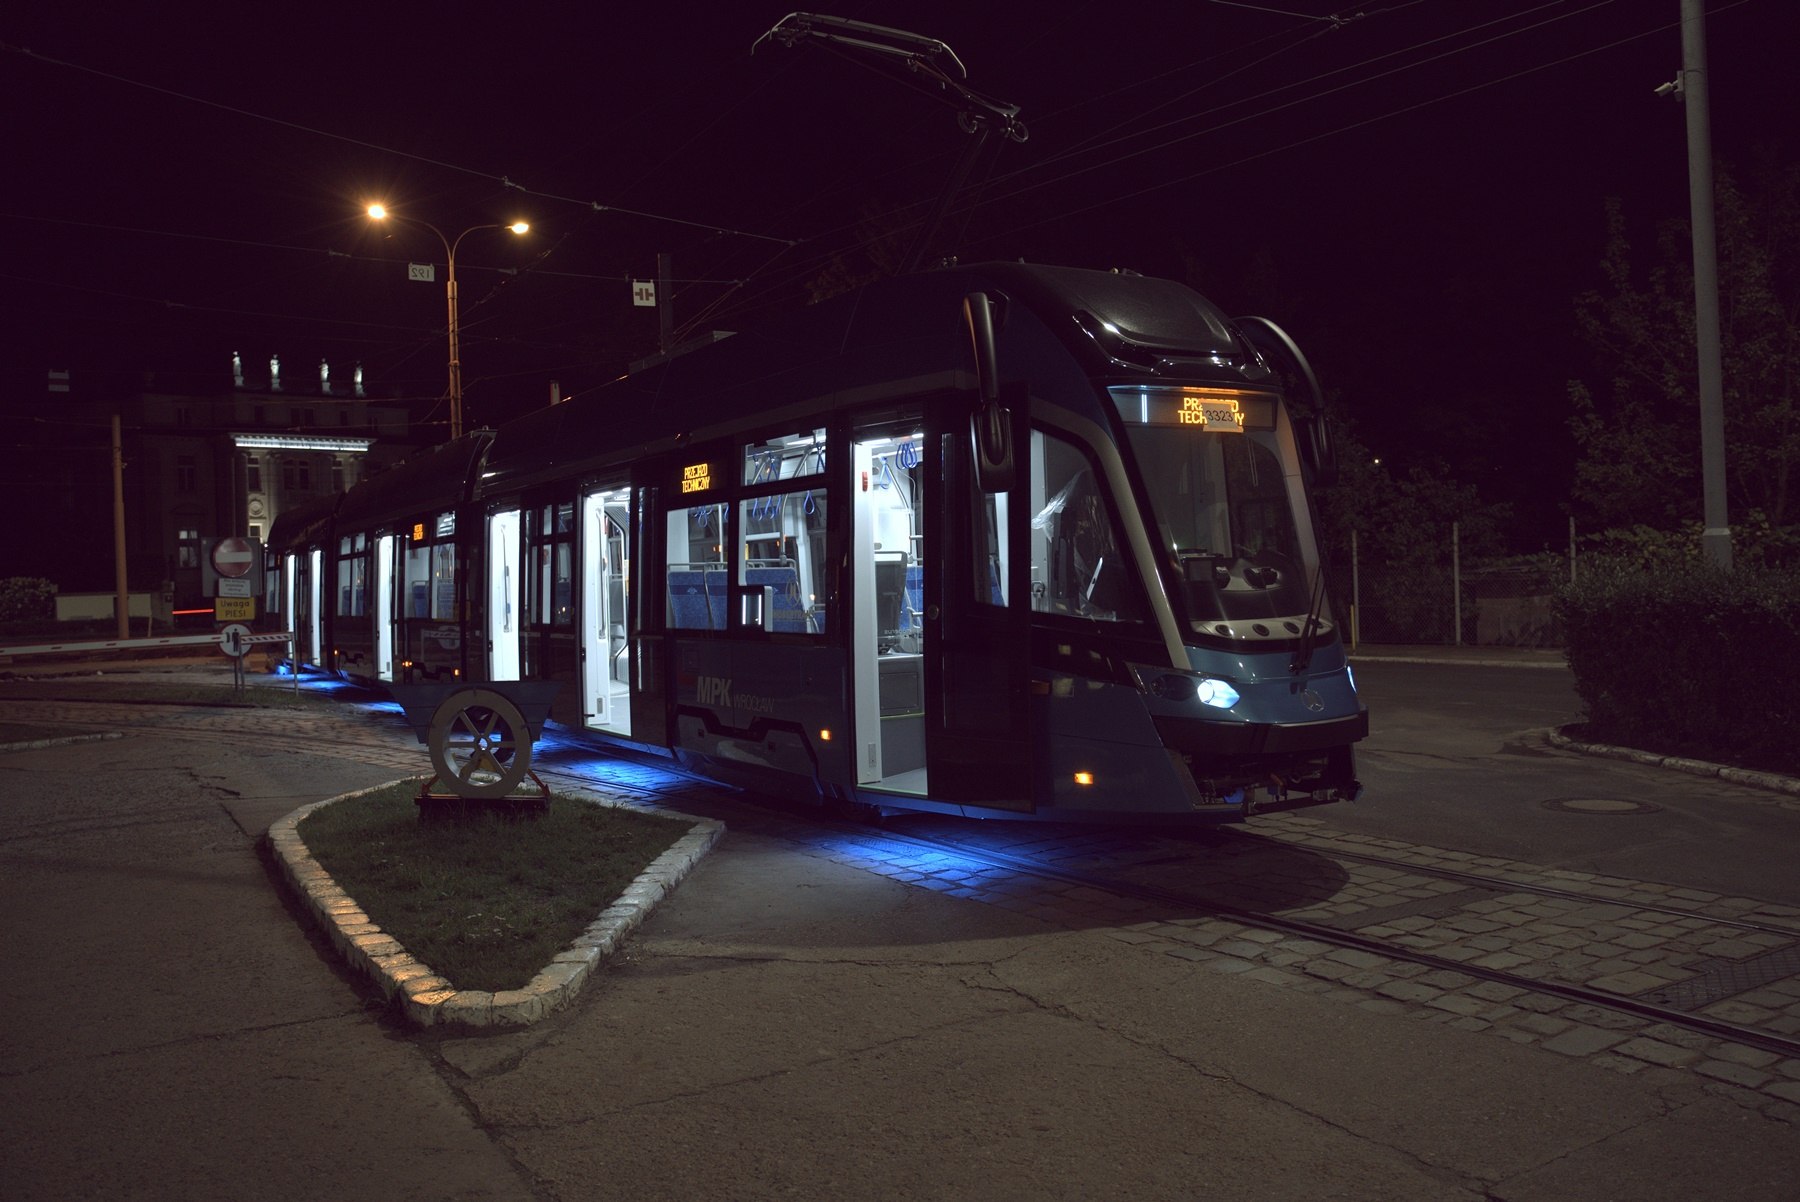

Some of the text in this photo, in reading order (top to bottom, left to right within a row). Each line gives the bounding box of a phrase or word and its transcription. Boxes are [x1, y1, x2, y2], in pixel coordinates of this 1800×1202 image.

[1205, 409, 1234, 422] 3323
[220, 600, 250, 609] Uwaga
[696, 676, 732, 707] MPK
